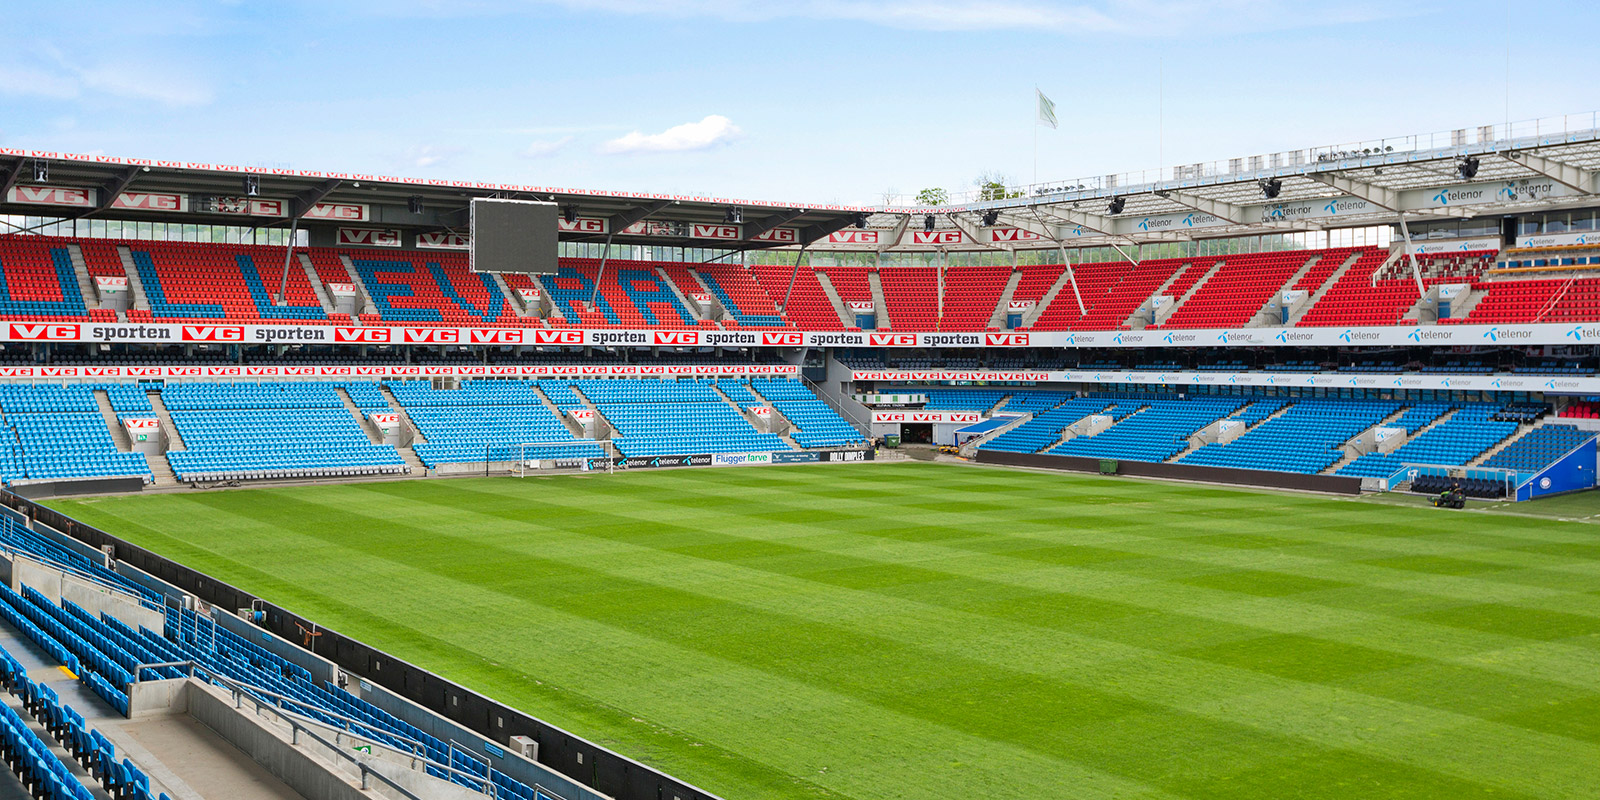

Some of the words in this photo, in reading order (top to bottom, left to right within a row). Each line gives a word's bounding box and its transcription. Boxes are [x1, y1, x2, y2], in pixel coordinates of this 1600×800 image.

[18, 187, 86, 204] VG
[1448, 190, 1483, 200] telenor
[1514, 183, 1553, 194] telenor
[118, 193, 177, 209] VG
[1336, 202, 1367, 210] telenor
[309, 204, 360, 220] VG
[559, 218, 601, 231] VG
[1148, 220, 1172, 228] telenor
[697, 225, 736, 238] VG
[758, 229, 793, 240] VG
[831, 231, 877, 242] VG
[994, 230, 1037, 240] VG
[342, 230, 394, 245] VG
[423, 234, 469, 246] VG
[916, 232, 959, 243] VG
[97, 278, 126, 286] VG
[12, 324, 78, 339] VG
[93, 326, 170, 341] sporten
[185, 326, 242, 340] VG
[256, 328, 324, 342] sporten
[337, 328, 388, 341] VG
[406, 329, 456, 342] VG
[472, 330, 521, 342] VG
[537, 331, 582, 343] VG
[592, 332, 646, 344] sporten
[656, 332, 697, 344] VG
[706, 332, 755, 345] sporten
[764, 333, 801, 345] VG
[810, 334, 863, 346] sporten
[871, 334, 915, 345] VG
[924, 334, 980, 346] sporten
[987, 334, 1027, 345] VG
[1287, 332, 1314, 340] telenor
[1421, 331, 1452, 339] telenor
[1497, 330, 1532, 338] telenor
[1582, 328, 1600, 337] tele
[87, 368, 118, 376] VG
[128, 368, 160, 376] VG
[170, 368, 200, 376] VG
[209, 368, 239, 376] VG
[373, 414, 399, 422] VG
[127, 420, 158, 428] VG
[716, 454, 745, 465] Flügger
[747, 454, 767, 462] farve
[830, 453, 843, 462] DOLLY
